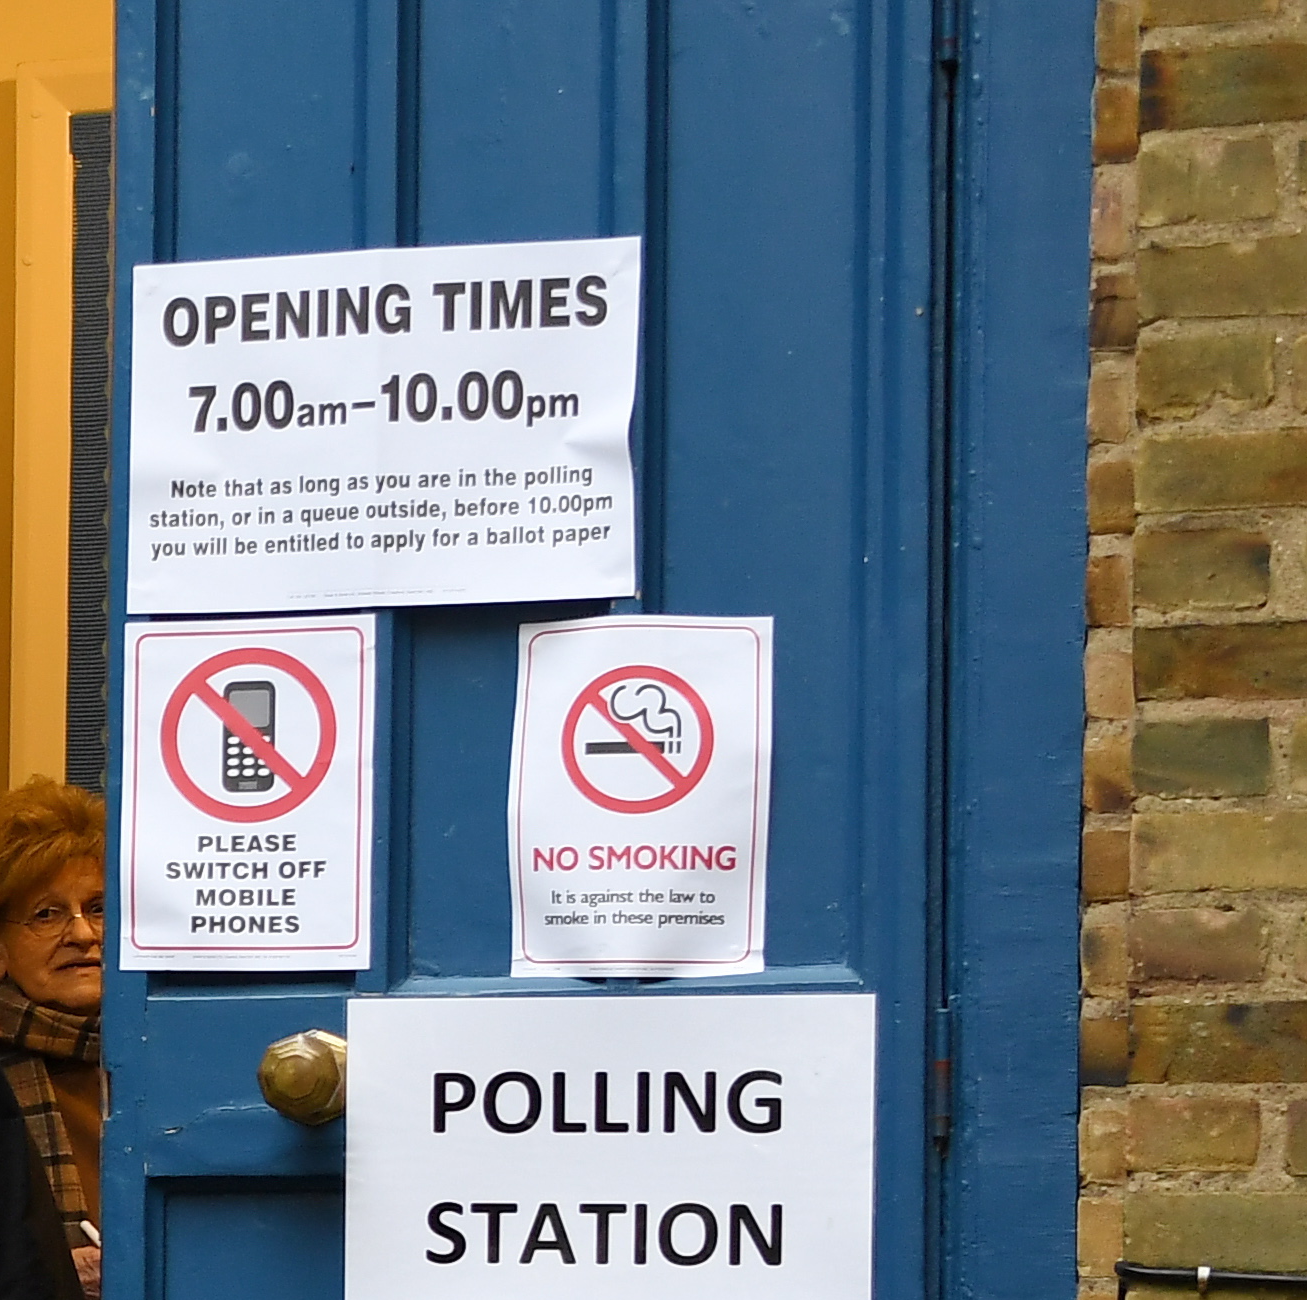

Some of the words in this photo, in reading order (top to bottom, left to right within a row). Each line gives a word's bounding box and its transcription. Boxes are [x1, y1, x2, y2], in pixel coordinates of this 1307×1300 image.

[164, 284, 411, 346] OPENING
[433, 276, 607, 331] TIMES
[172, 481, 216, 497] Note
[225, 479, 263, 496] that
[271, 481, 292, 494] as
[300, 476, 339, 496] long
[348, 476, 368, 490] as
[376, 475, 410, 493] you
[419, 474, 450, 488] are
[459, 469, 476, 486] in
[485, 468, 516, 486] the
[525, 466, 592, 490] polling
[150, 509, 224, 529] station,
[232, 512, 251, 525] or
[259, 507, 274, 524] in
[283, 510, 292, 523] a
[301, 507, 359, 525] queue
[366, 500, 446, 520] outside,
[455, 498, 519, 516] before
[529, 495, 612, 516] 10.00pm
[152, 543, 185, 561] you
[193, 538, 227, 555] will
[235, 537, 257, 554] be
[265, 533, 339, 553] entitled
[347, 532, 363, 549] to
[371, 530, 425, 552] apply
[433, 529, 459, 546] for
[468, 532, 478, 545] a
[487, 526, 544, 544] ballot
[553, 526, 610, 546] paper
[199, 834, 296, 852] PLEASE
[167, 862, 268, 879] SWITCH
[279, 861, 326, 878] OFF
[534, 847, 578, 871] NO
[590, 846, 736, 871] SMOKING
[197, 889, 295, 906] MOBILE
[552, 890, 562, 904] It
[567, 890, 576, 903] is
[581, 889, 633, 907] against
[639, 889, 664, 903] the
[670, 889, 695, 903] law
[700, 892, 715, 903] to
[192, 916, 299, 933] PHONES
[545, 911, 588, 925] smoke
[594, 911, 606, 924] in
[612, 910, 653, 924] these
[658, 911, 725, 928] premises
[434, 1071, 782, 1133] POLLING
[427, 1202, 782, 1266] STATION
